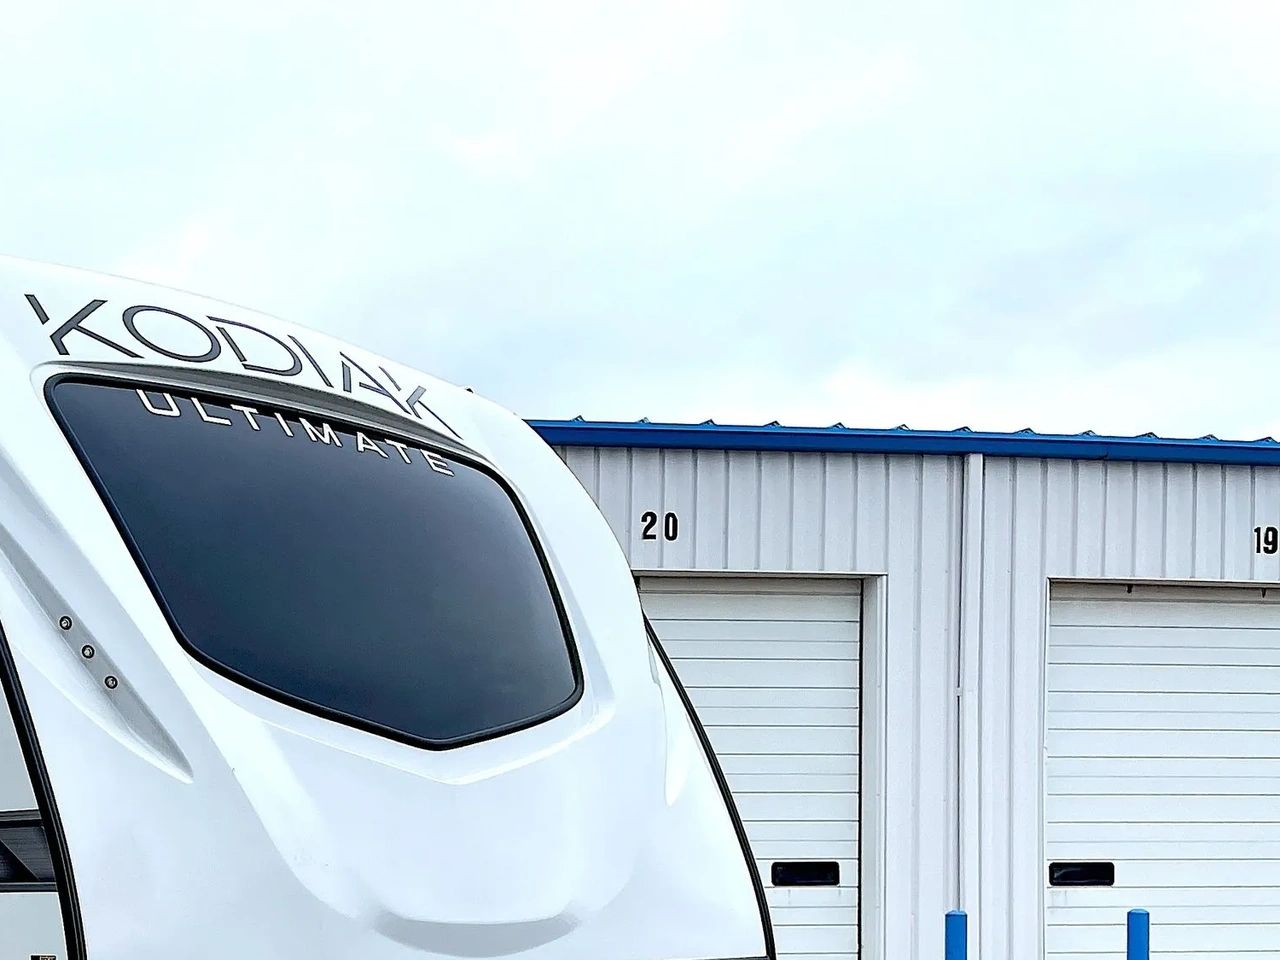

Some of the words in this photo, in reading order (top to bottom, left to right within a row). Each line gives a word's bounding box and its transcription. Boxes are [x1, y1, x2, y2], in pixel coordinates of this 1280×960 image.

[24, 294, 464, 440] KODIAK
[135, 388, 456, 477] ULTIMATE
[640, 511, 679, 541] 20
[1253, 526, 1279, 555] 19
